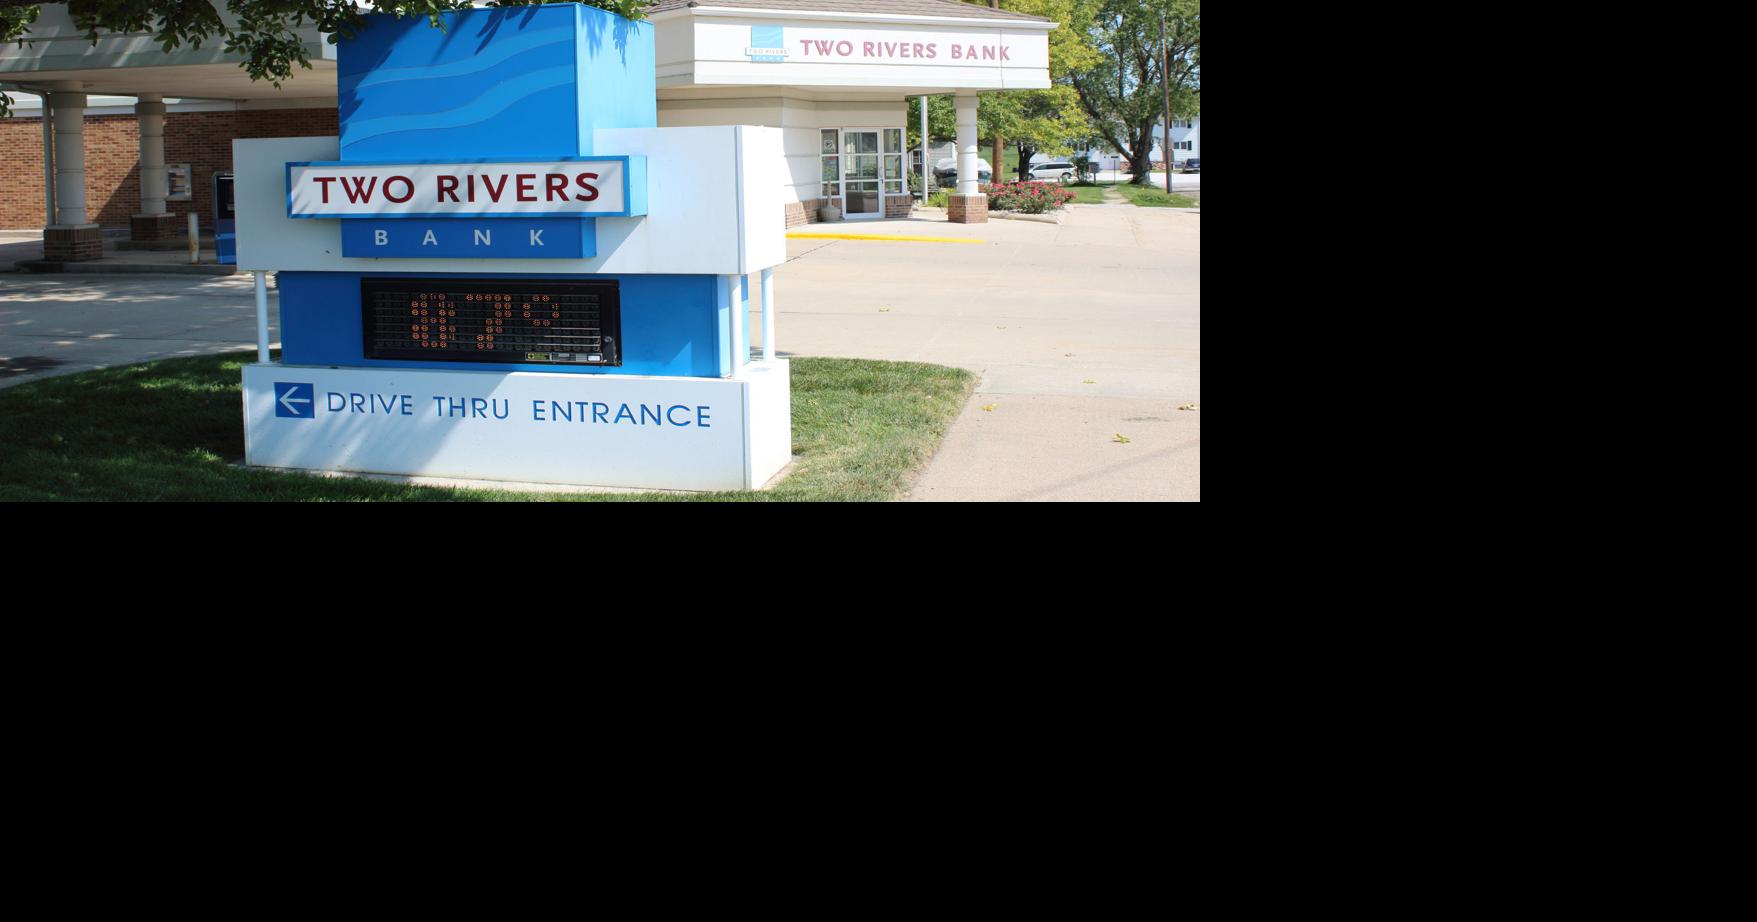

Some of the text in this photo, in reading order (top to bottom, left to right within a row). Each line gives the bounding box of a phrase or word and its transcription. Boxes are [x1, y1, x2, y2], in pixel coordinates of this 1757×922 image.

[800, 39, 1011, 61] TWO RIVERS BANK
[313, 173, 600, 204] TWO RIVERS
[327, 391, 711, 428] DRIVE THRU ENTRANCE
